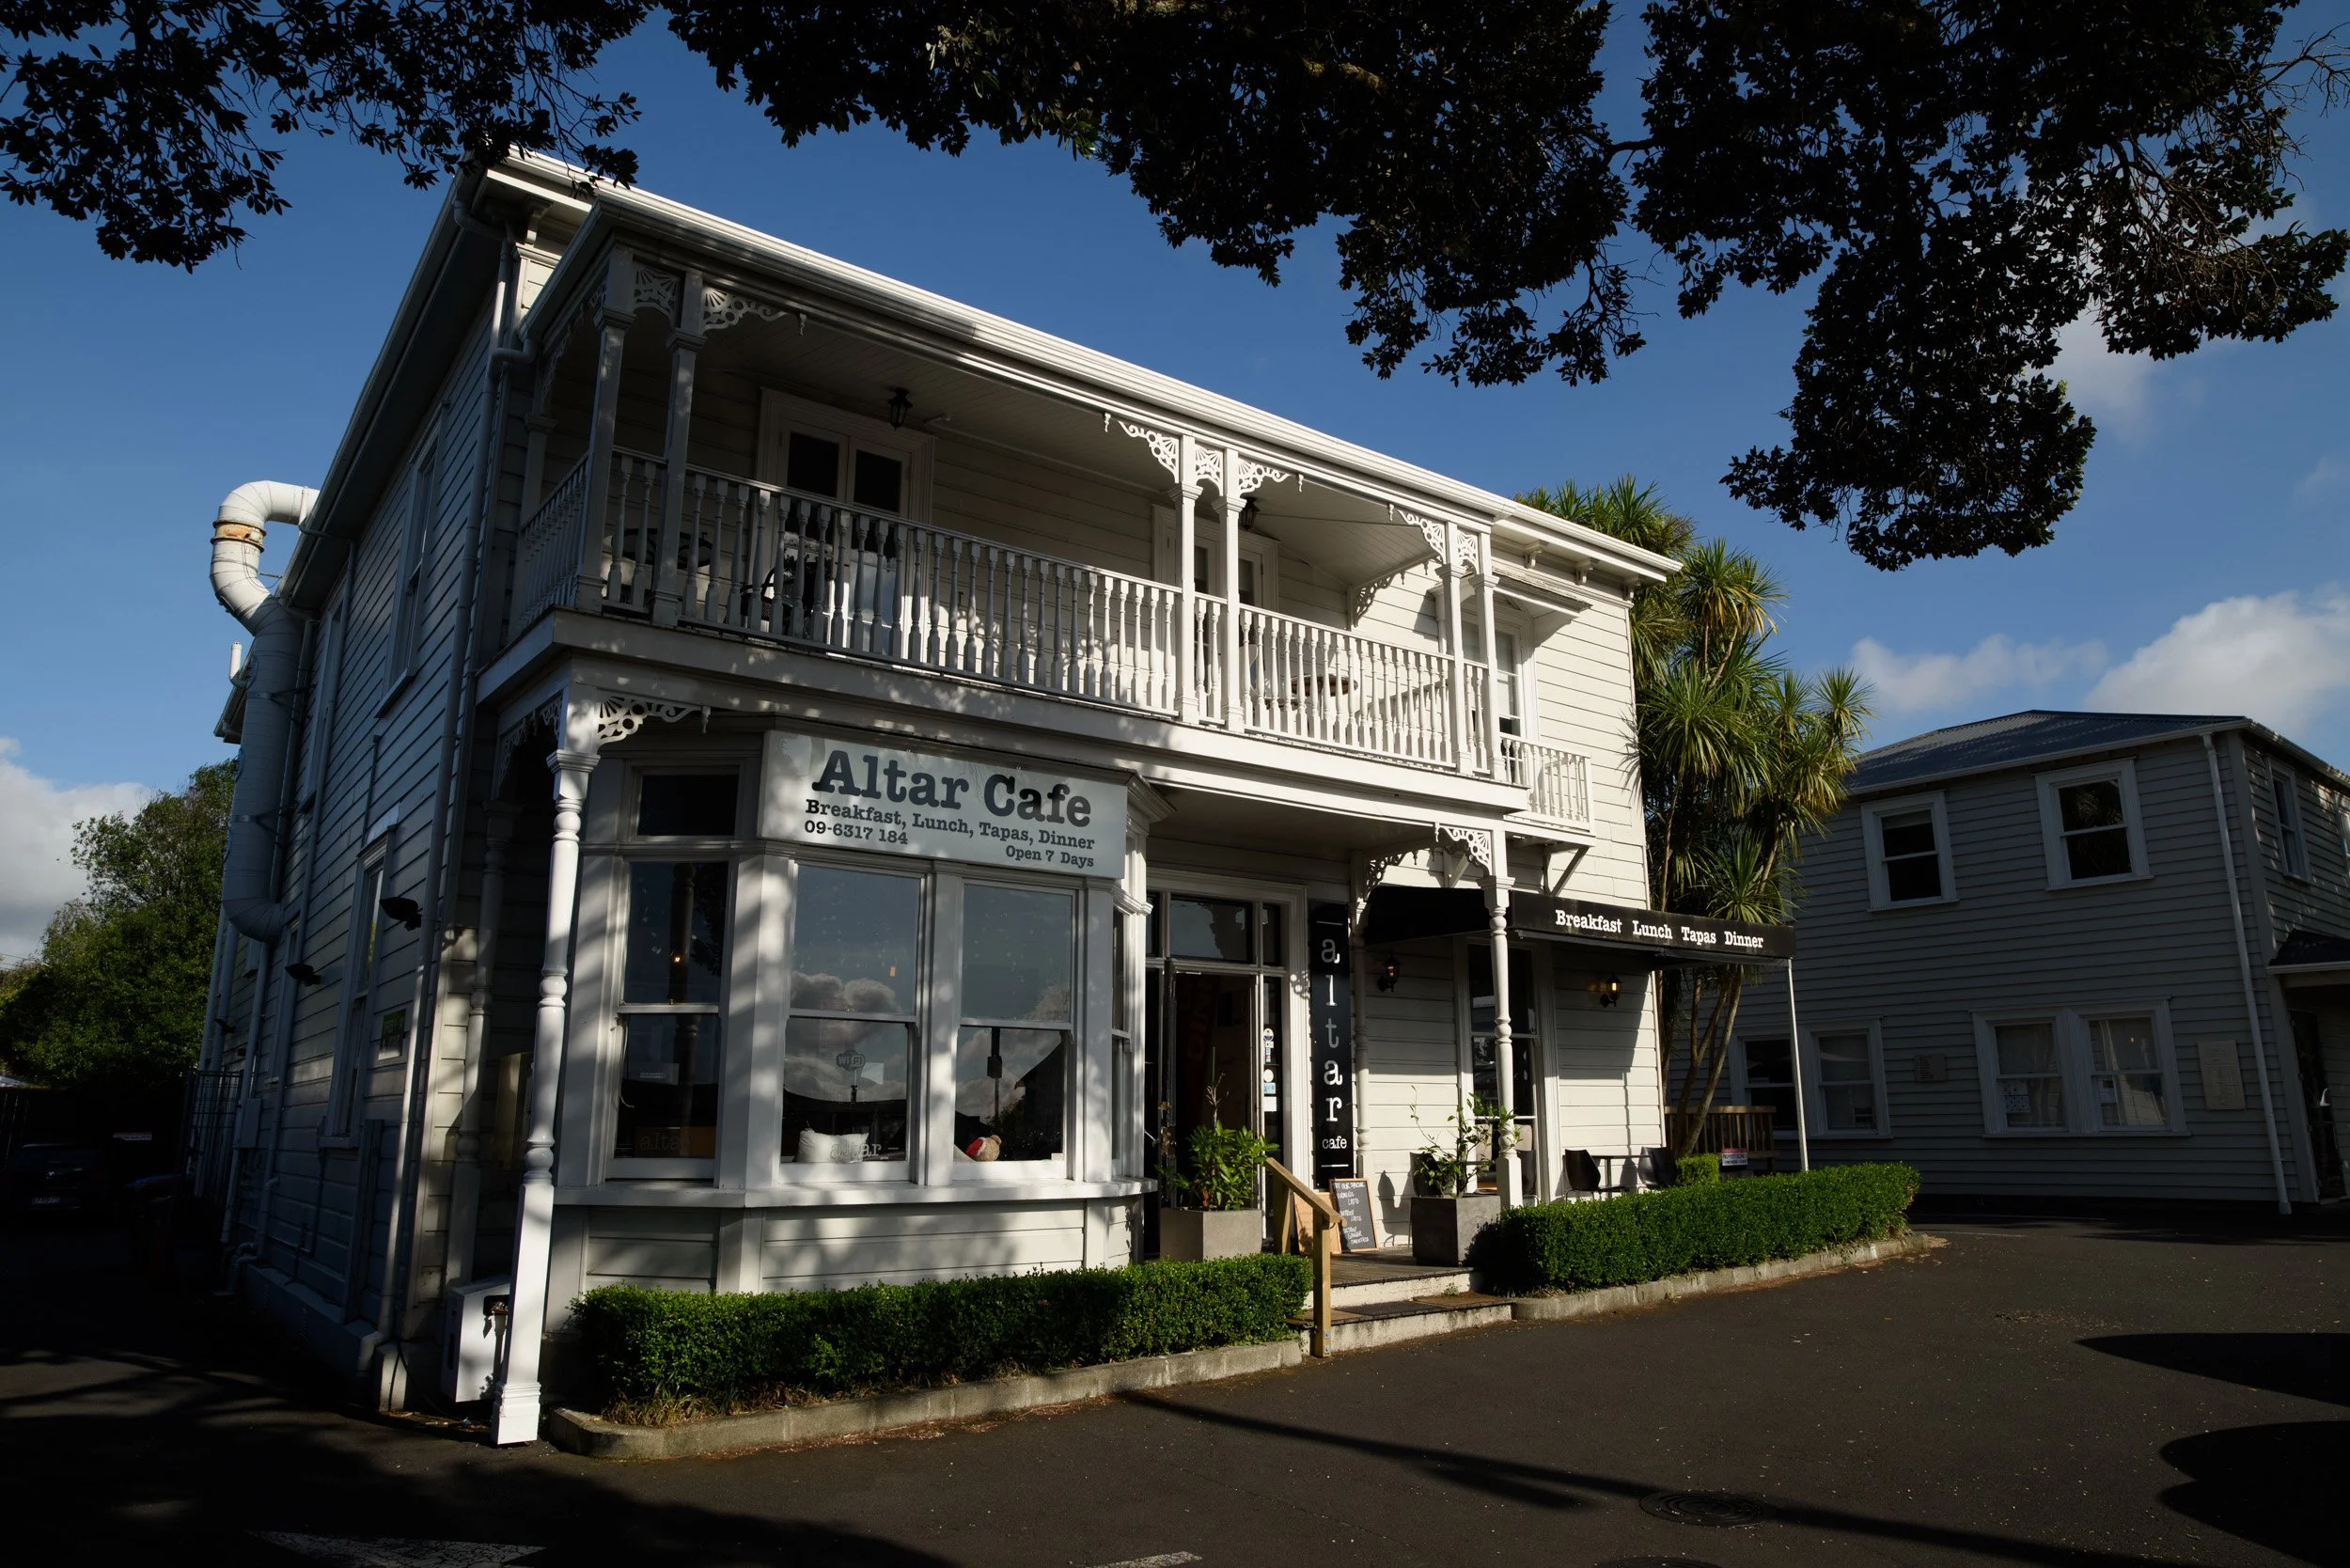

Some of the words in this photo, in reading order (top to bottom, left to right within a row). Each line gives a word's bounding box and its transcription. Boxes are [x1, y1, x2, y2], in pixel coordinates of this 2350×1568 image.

[811, 750, 969, 809] Altar
[983, 774, 1091, 827] Cafe
[804, 820, 873, 839] 09-6317
[878, 830, 908, 845] 184
[806, 799, 907, 829] Breakfast,
[912, 812, 974, 839] Lunch,
[979, 822, 1034, 846] Tapas,
[1039, 829, 1095, 850] Dinner
[1006, 845, 1042, 862] Open
[1046, 850, 1054, 863] 7
[1061, 851, 1095, 868] Days
[1555, 909, 1622, 933] Breakfast
[1632, 920, 1673, 940] Lunch
[1682, 926, 1716, 947] Tapas
[1724, 931, 1764, 949] Dinner
[1321, 938, 1343, 1122] altar
[831, 1138, 882, 1157] altar
[1322, 1136, 1348, 1151] cafe
